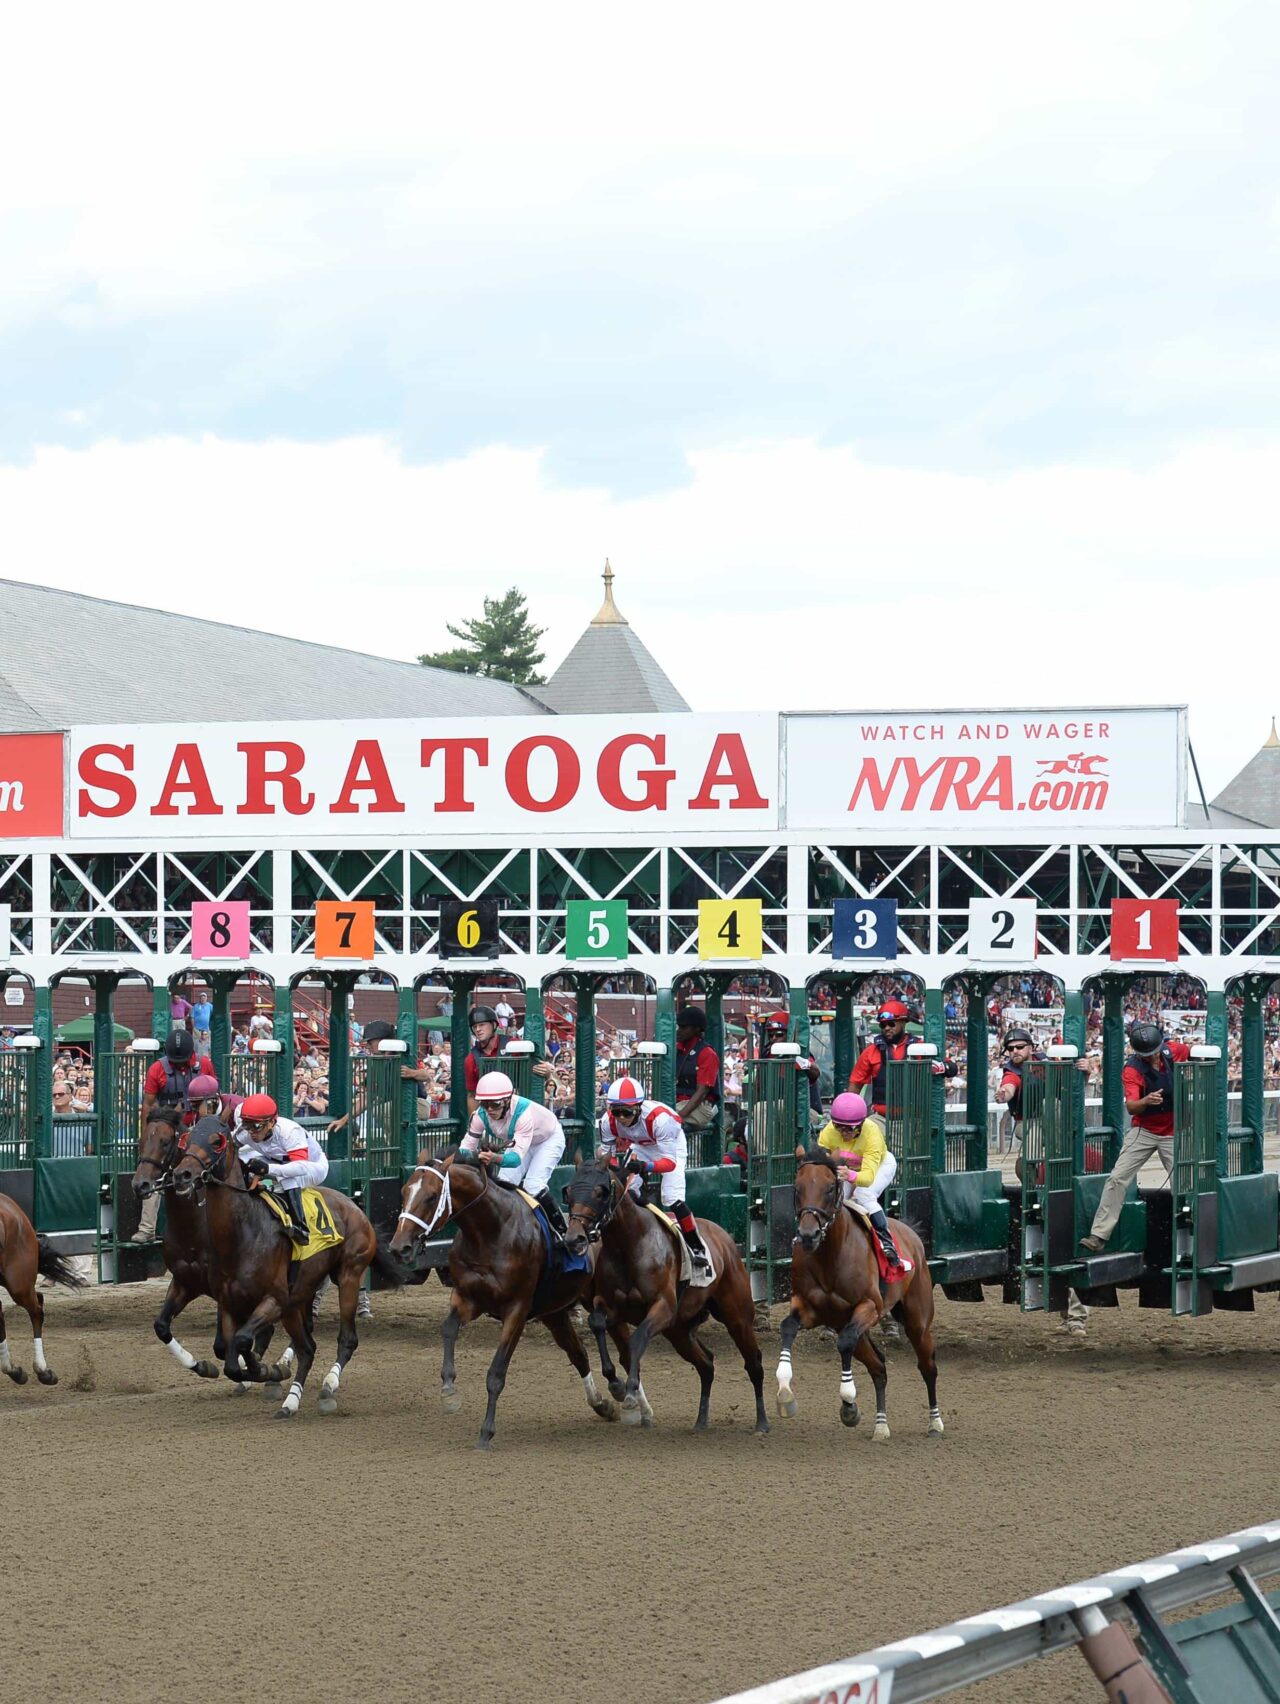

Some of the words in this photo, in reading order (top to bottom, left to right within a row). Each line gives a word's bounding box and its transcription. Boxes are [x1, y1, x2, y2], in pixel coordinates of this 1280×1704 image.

[861, 725, 944, 741] WATCH
[958, 724, 1009, 740] AND
[1023, 723, 1110, 740] WAGER
[77, 733, 769, 818] SARATOGA
[847, 756, 1109, 812] NYRA.com
[210, 911, 231, 948] 8
[335, 912, 357, 948] 7
[457, 910, 481, 948] 6
[587, 909, 610, 948] 5
[717, 910, 741, 948] 4
[853, 909, 878, 949] 3
[990, 910, 1016, 948] 2
[1134, 909, 1153, 950] 1
[315, 1197, 336, 1241] 4
